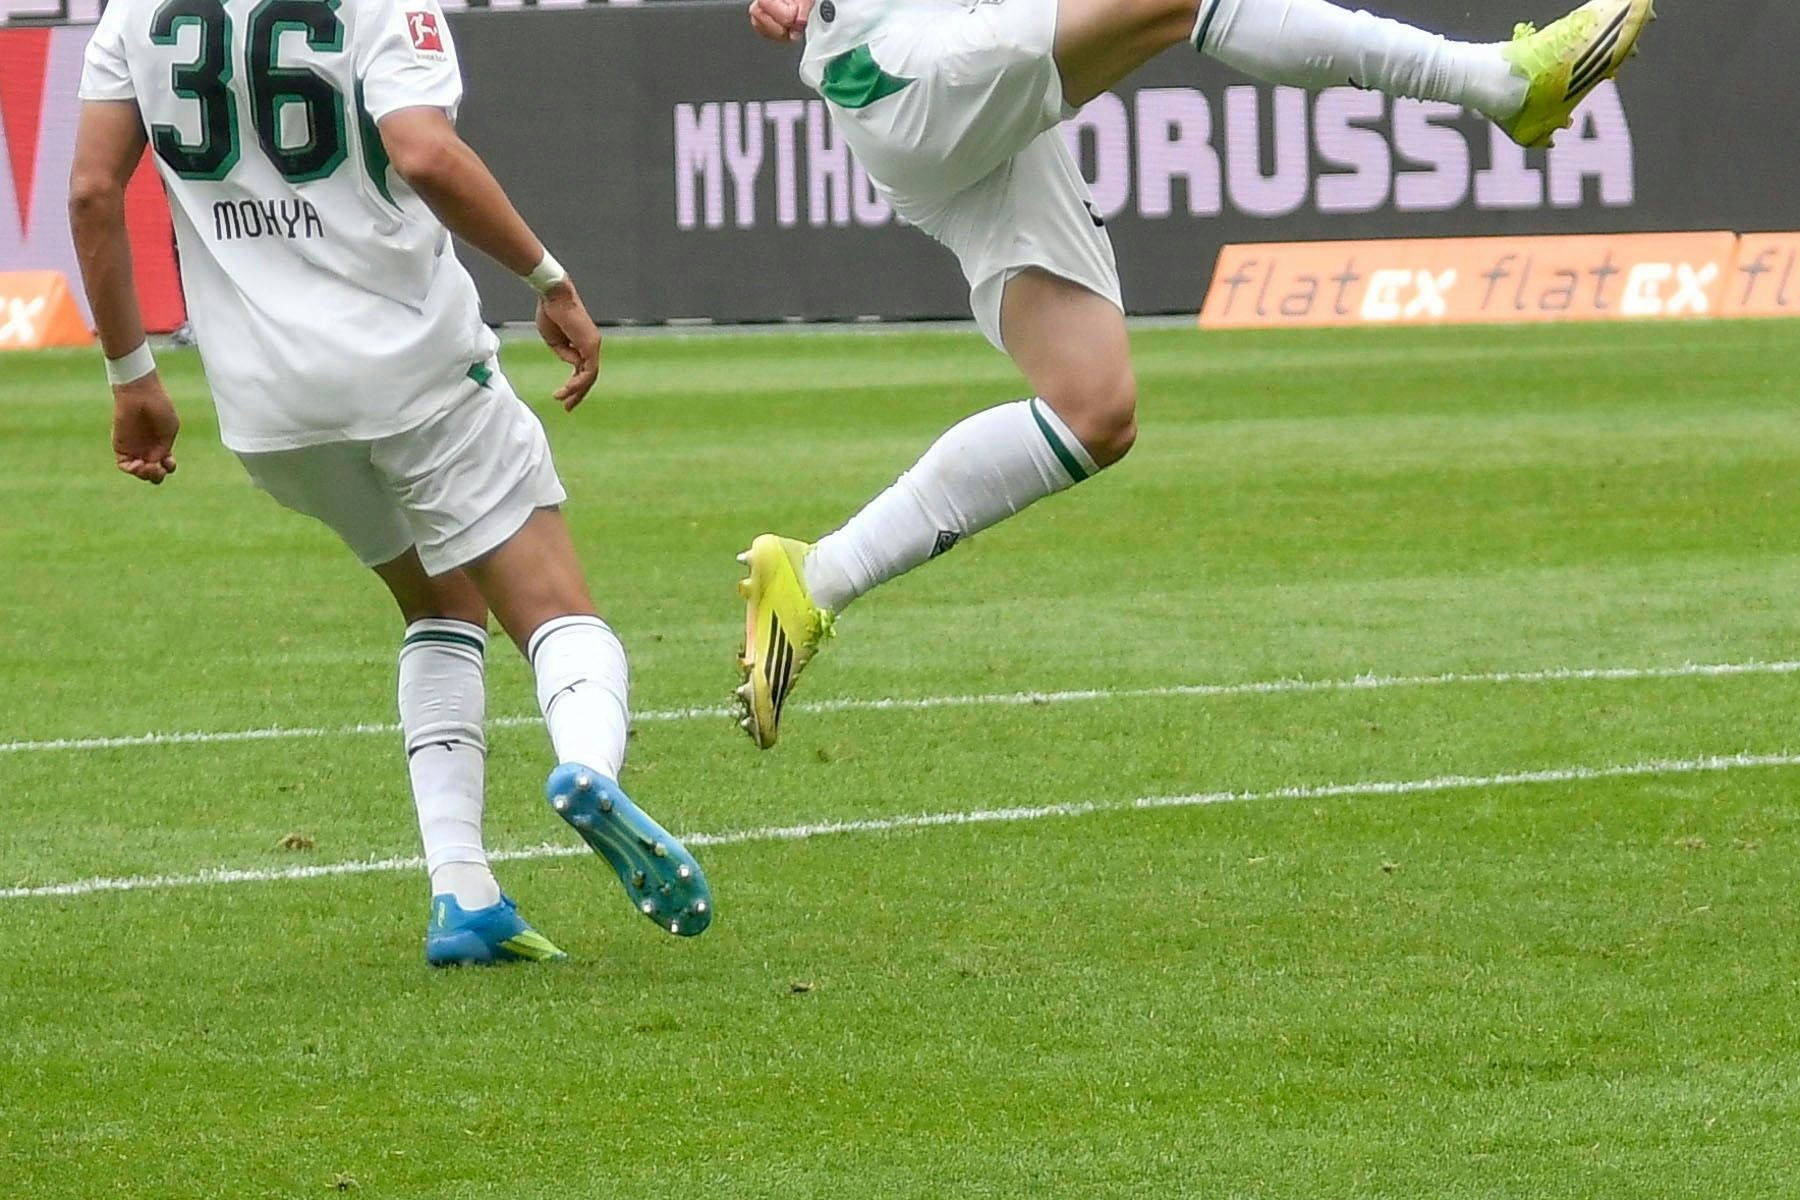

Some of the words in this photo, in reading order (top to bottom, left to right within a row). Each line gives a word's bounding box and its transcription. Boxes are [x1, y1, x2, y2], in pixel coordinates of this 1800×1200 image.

[674, 100, 908, 228] MYTH
[1062, 84, 1634, 218] ORUSSIA
[212, 198, 325, 241] MOHYA
